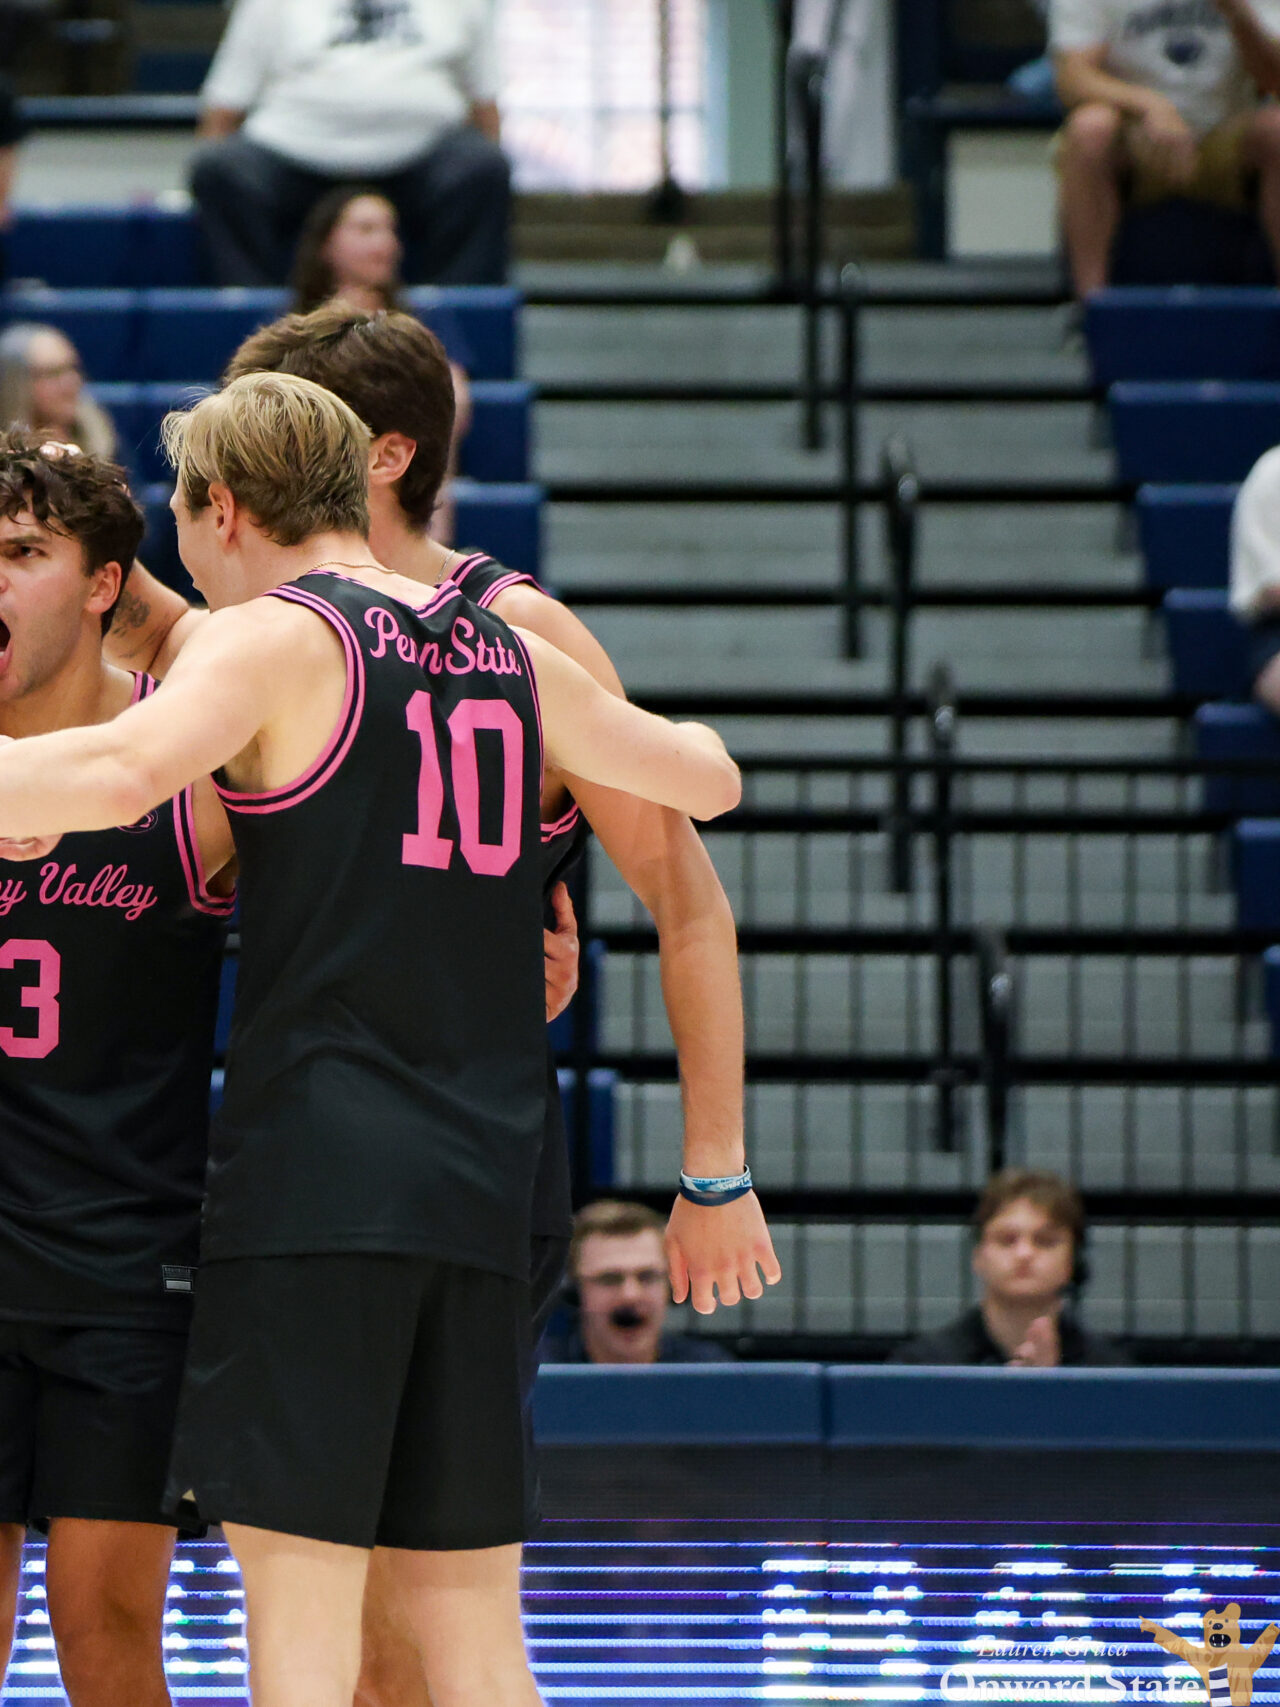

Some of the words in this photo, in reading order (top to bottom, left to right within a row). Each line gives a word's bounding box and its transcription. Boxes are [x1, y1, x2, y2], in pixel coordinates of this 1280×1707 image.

[363, 606, 443, 675] Penn
[444, 616, 522, 677] State
[402, 689, 524, 877] 10
[38, 861, 158, 921] Valley
